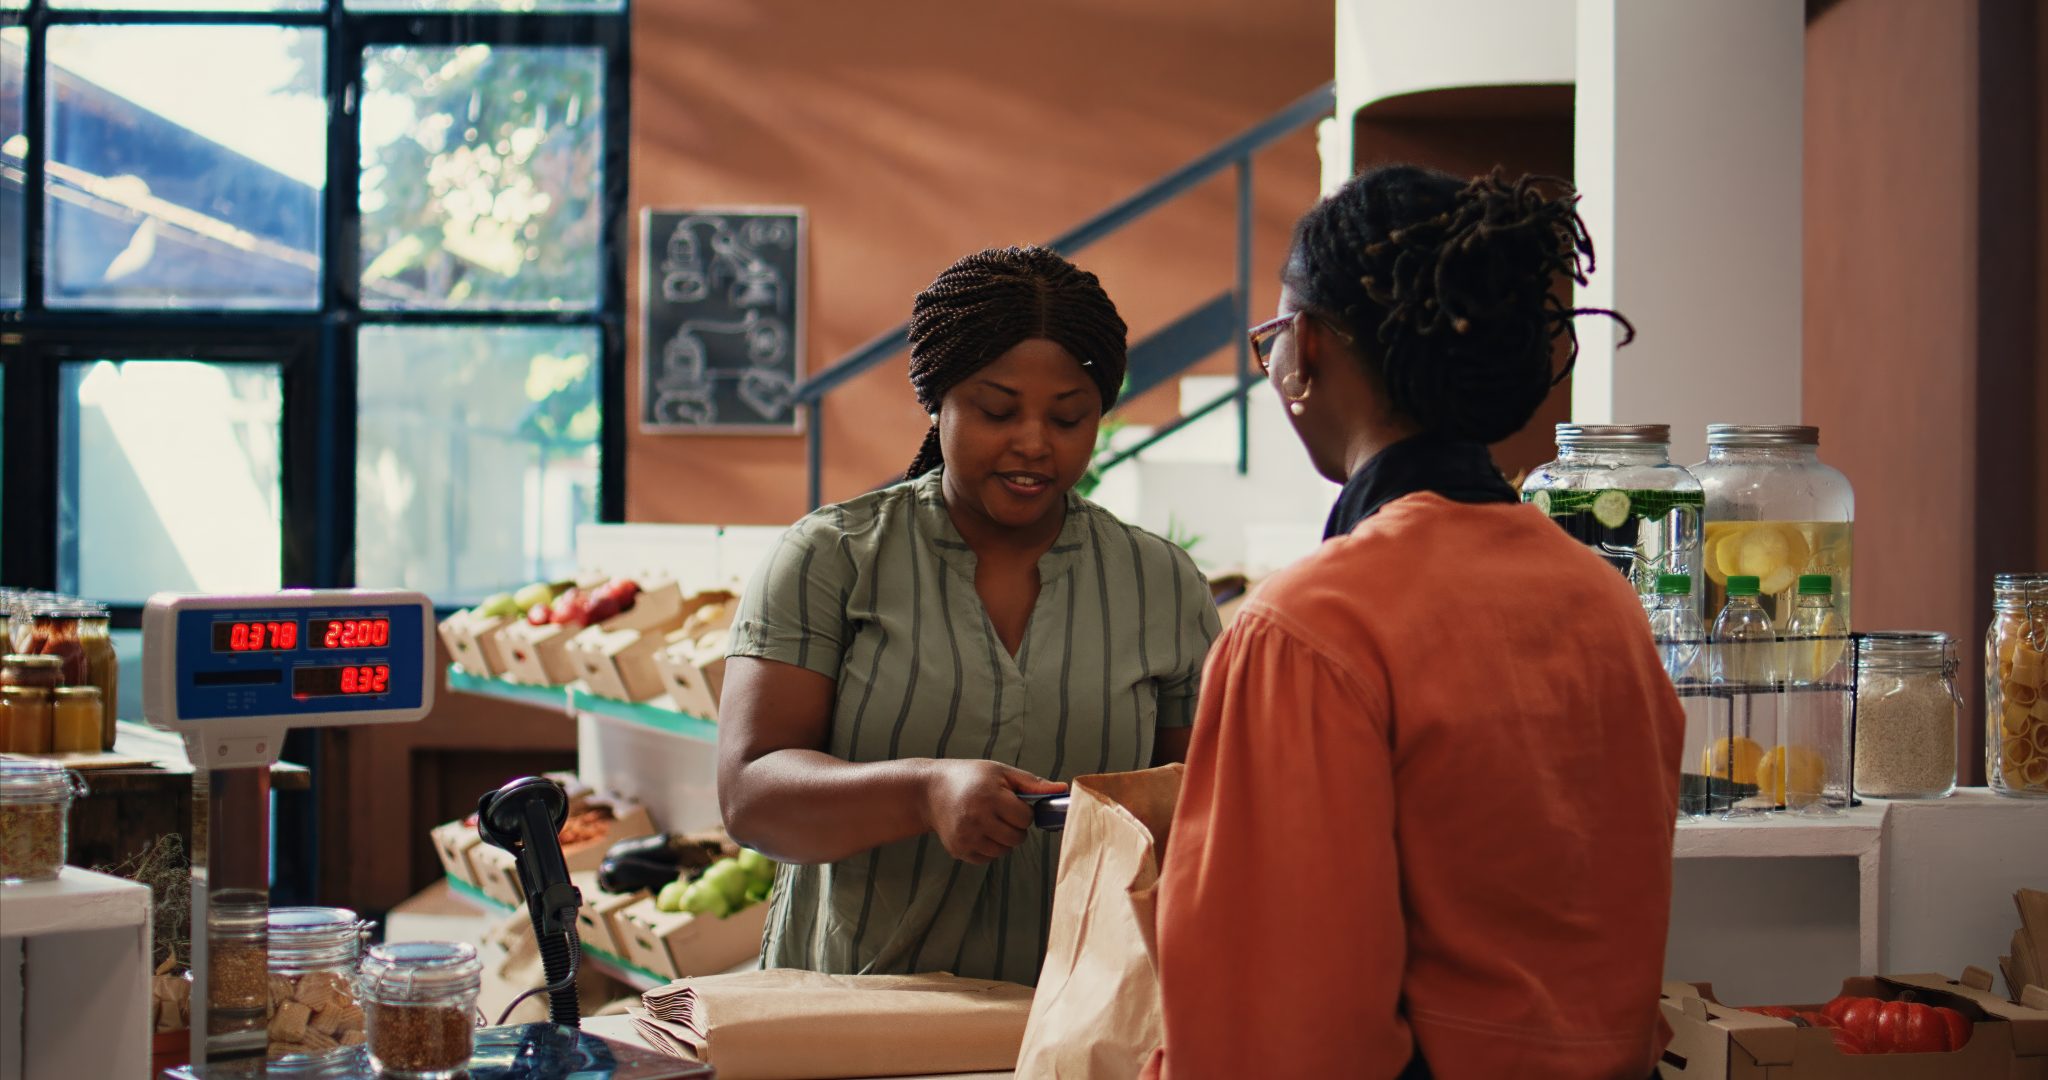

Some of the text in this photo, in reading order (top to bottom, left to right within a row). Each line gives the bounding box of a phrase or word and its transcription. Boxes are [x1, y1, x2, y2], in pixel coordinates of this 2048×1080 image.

[230, 621, 298, 651] 0.378
[324, 620, 389, 648] 22.00
[341, 666, 389, 693] 8.32
